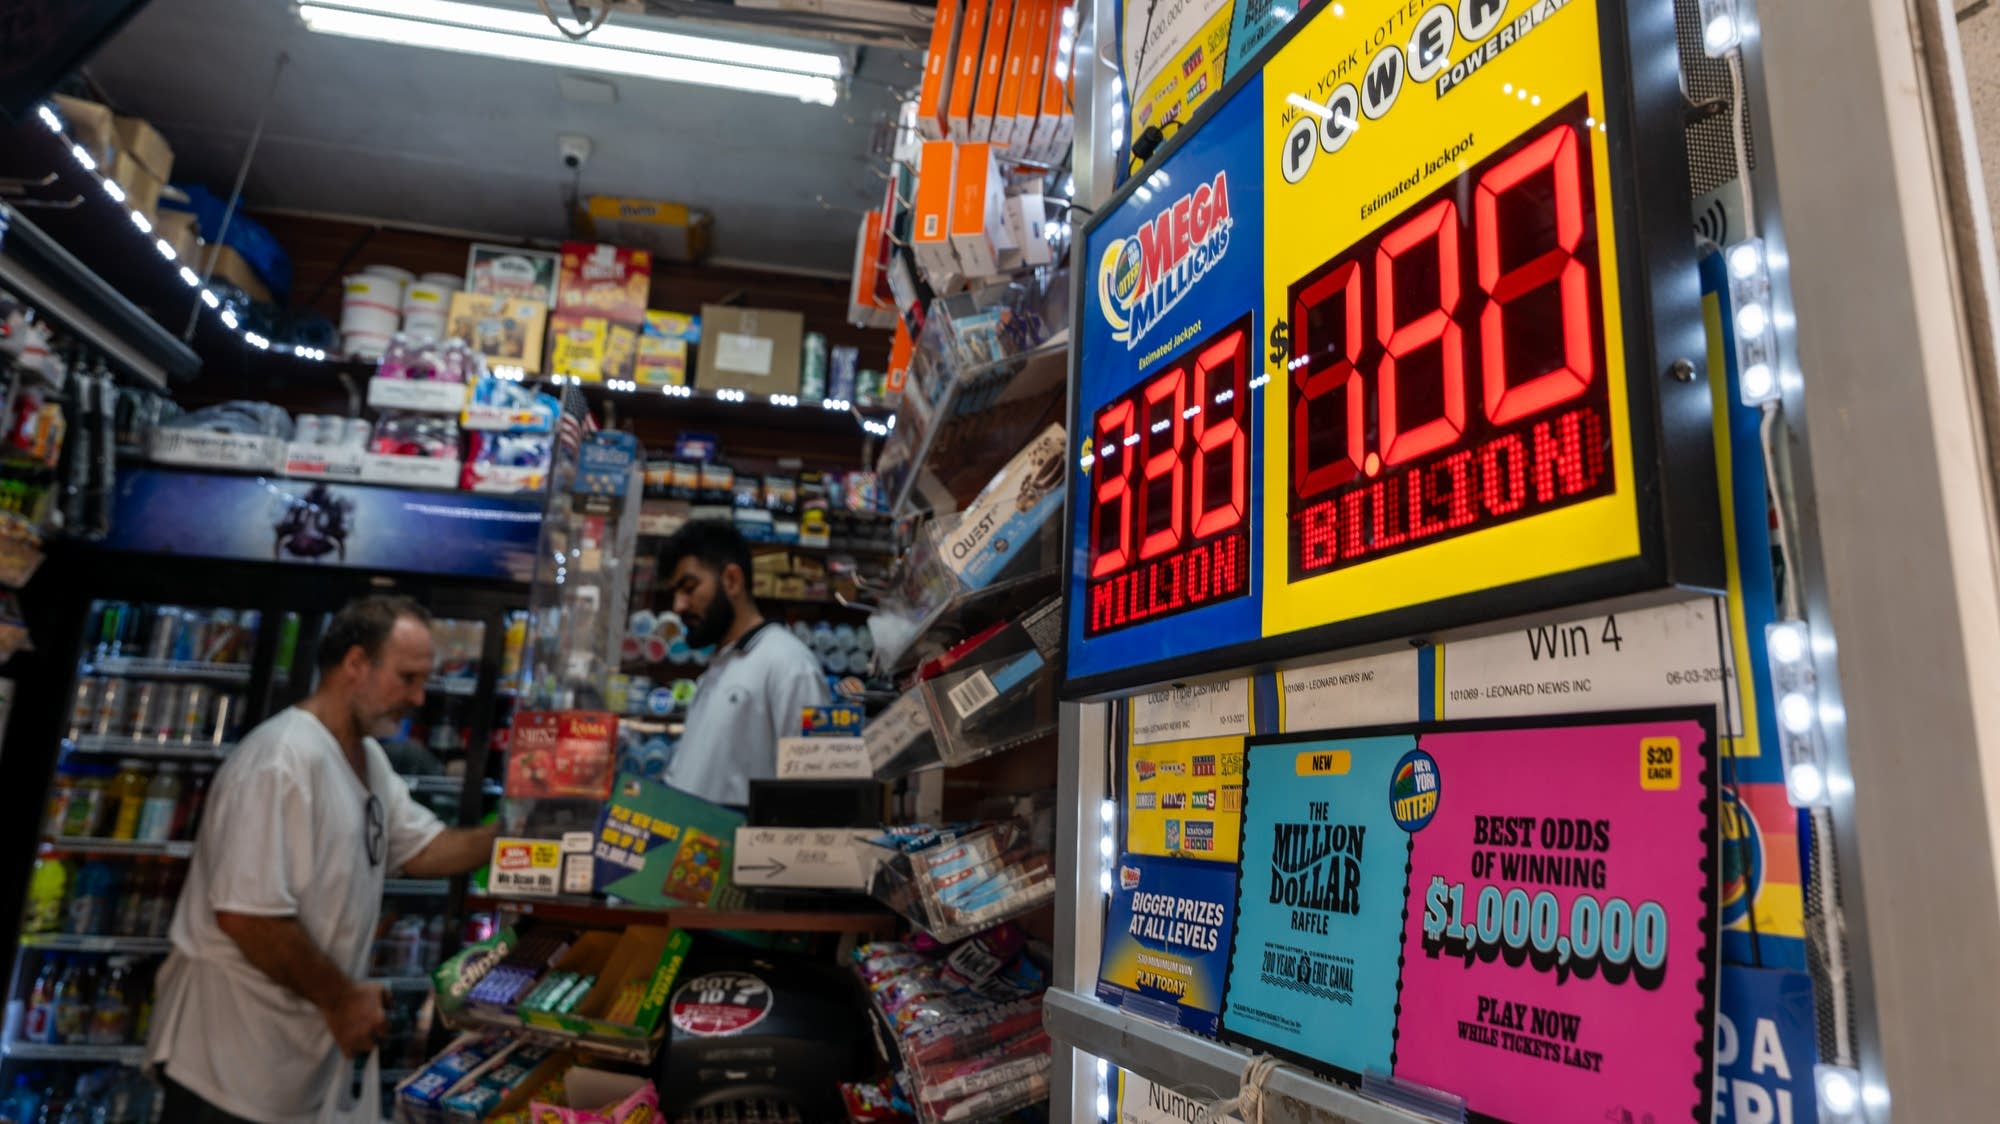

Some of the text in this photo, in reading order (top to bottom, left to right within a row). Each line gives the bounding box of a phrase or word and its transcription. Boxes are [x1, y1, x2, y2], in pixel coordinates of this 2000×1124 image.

[1317, 55, 1358, 93] YORK
[1360, 132, 1475, 220] Estimated Jackpot
[1135, 170, 1229, 300] MEGA
[1128, 225, 1230, 350] MILLIONS
[1139, 321, 1202, 370] Estimated Jackpot
[1300, 409, 1594, 571] BILLION
[952, 514, 995, 559] QUEST
[1091, 533, 1242, 632] MILLION
[1526, 614, 1622, 661] Win 4
[1309, 676, 1338, 690] LEONARD
[1339, 672, 1360, 685] NEWS
[1361, 670, 1374, 681] INC
[1450, 688, 1479, 701] 101069
[1486, 683, 1534, 698] LEONARD
[1537, 680, 1570, 695] NEWS
[1573, 678, 1591, 692] INC
[1312, 755, 1333, 771] NEW
[1414, 759, 1431, 774] NEW
[1647, 747, 1673, 765] $20
[1648, 767, 1672, 780] EACH
[1414, 773, 1436, 793] YORK
[1309, 802, 1329, 821] THE
[1394, 790, 1437, 822] LOTTERY
[1272, 823, 1366, 873] MILLION
[1473, 815, 1611, 852] BEST ODDS
[1472, 851, 1607, 890] OF WINNING
[1132, 891, 1224, 927] BIGGER PRIZES
[1291, 910, 1329, 936] RAFFLE
[1423, 876, 1668, 978] $1,000,000
[1129, 914, 1218, 952] AT ALL LEVELS
[691, 977, 734, 992] GOT
[1136, 970, 1187, 996] PLAY TODAY!
[1262, 950, 1354, 993] 200 YEARS ERIE CANAL
[698, 990, 725, 1004] ID
[1477, 996, 1581, 1043] PLAY NOW
[1457, 1021, 1602, 1072] WHILE TICKETS LAST
